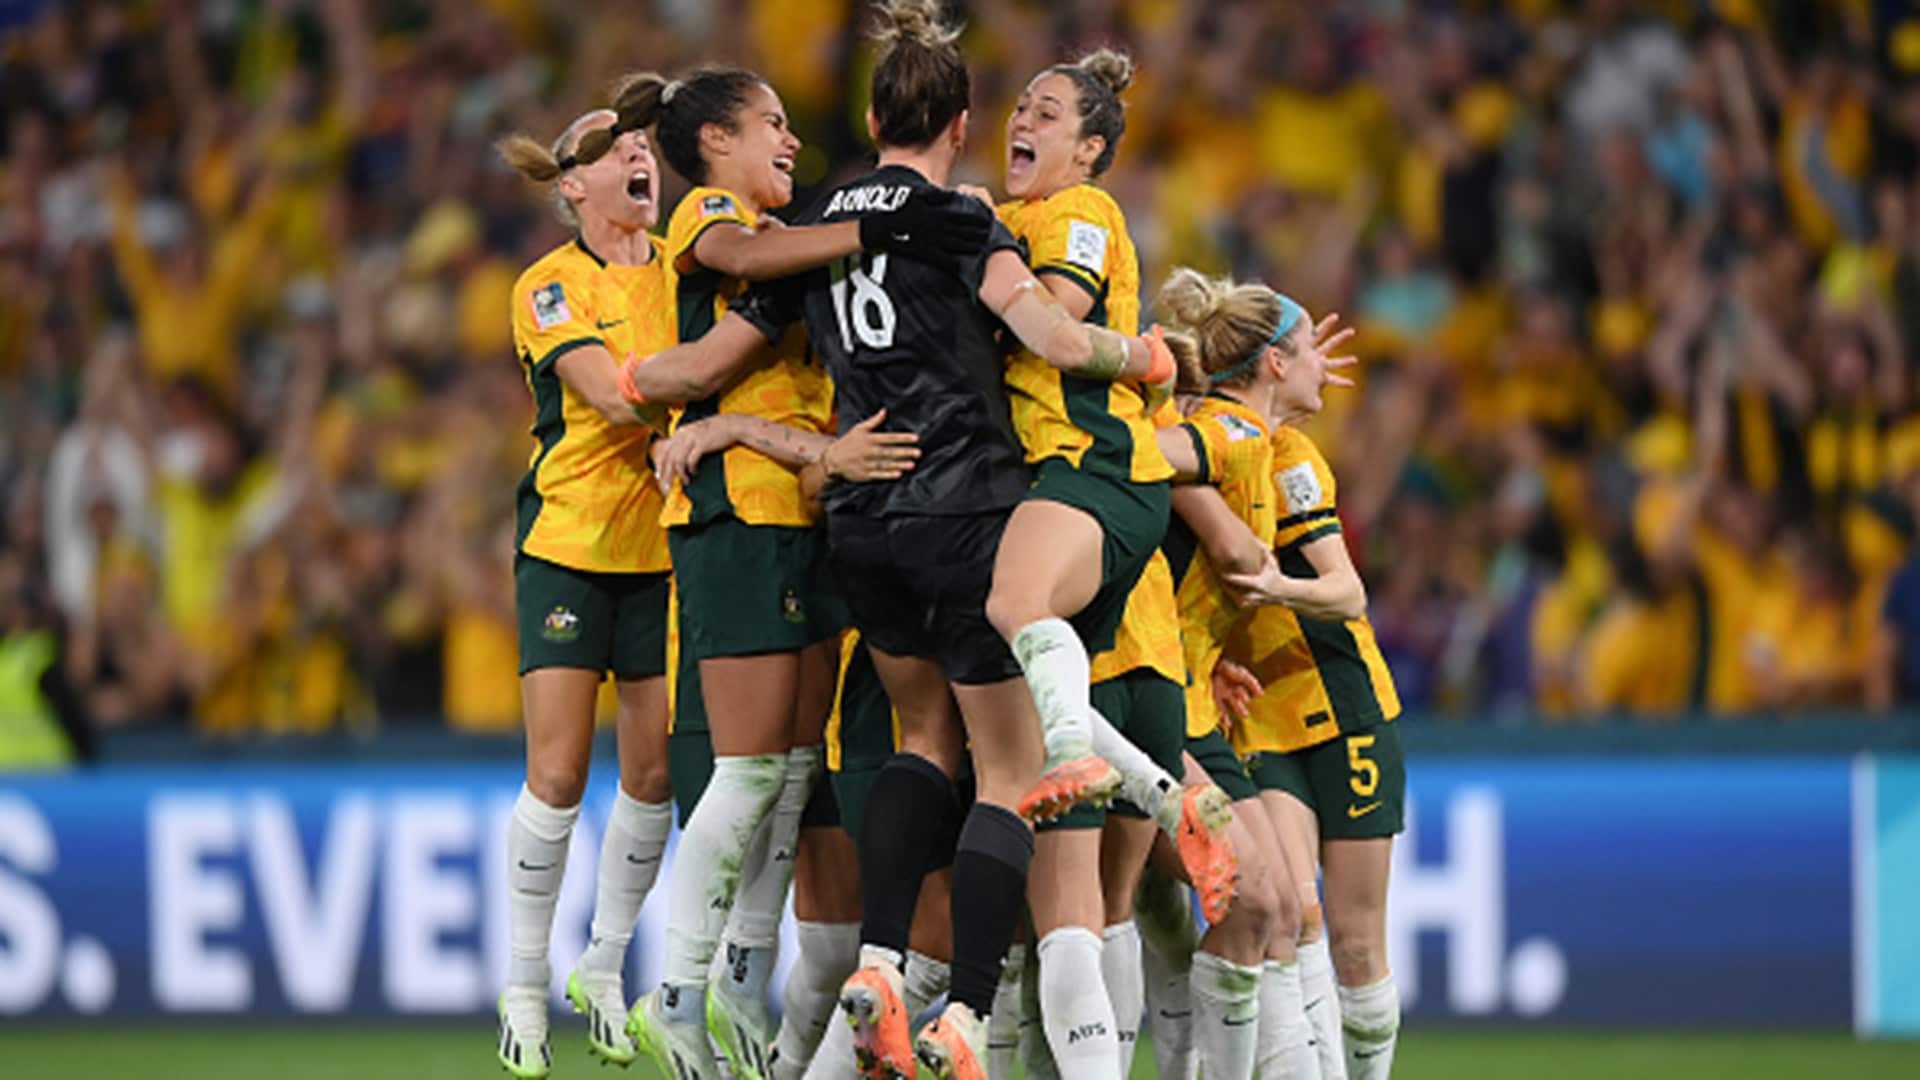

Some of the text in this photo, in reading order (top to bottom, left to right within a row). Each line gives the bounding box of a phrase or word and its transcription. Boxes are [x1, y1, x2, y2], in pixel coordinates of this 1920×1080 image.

[823, 183, 912, 218] ARNOLD
[829, 252, 897, 353] 18
[1346, 734, 1380, 797] 5
